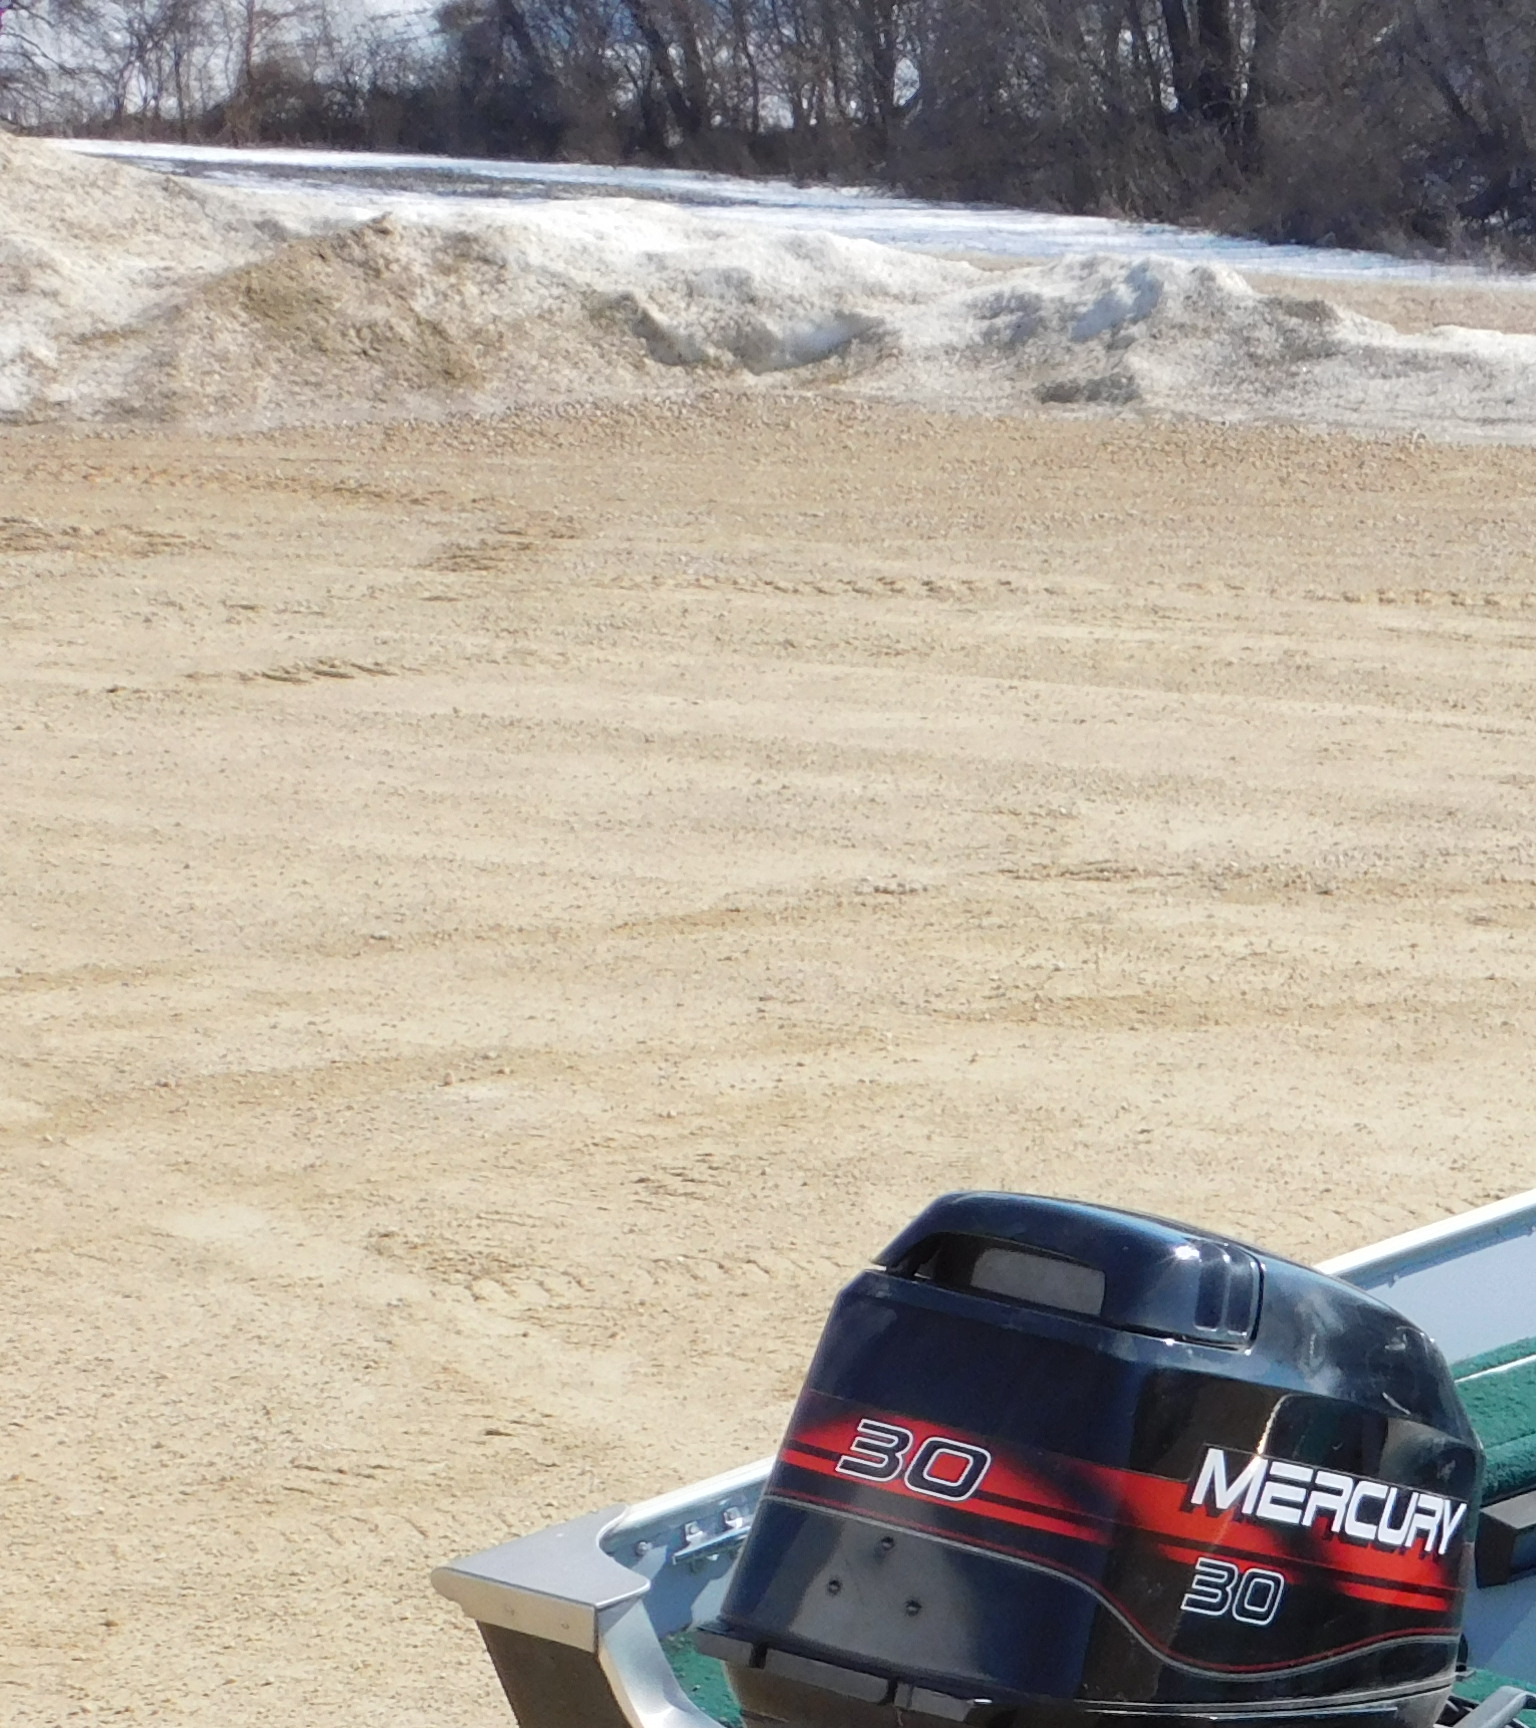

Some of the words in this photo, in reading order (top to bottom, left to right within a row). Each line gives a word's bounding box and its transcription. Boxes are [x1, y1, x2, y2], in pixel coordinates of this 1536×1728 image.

[835, 1418, 991, 1502] 30
[1190, 1447, 1468, 1556] MERCURY
[1180, 1556, 1285, 1627] 30
